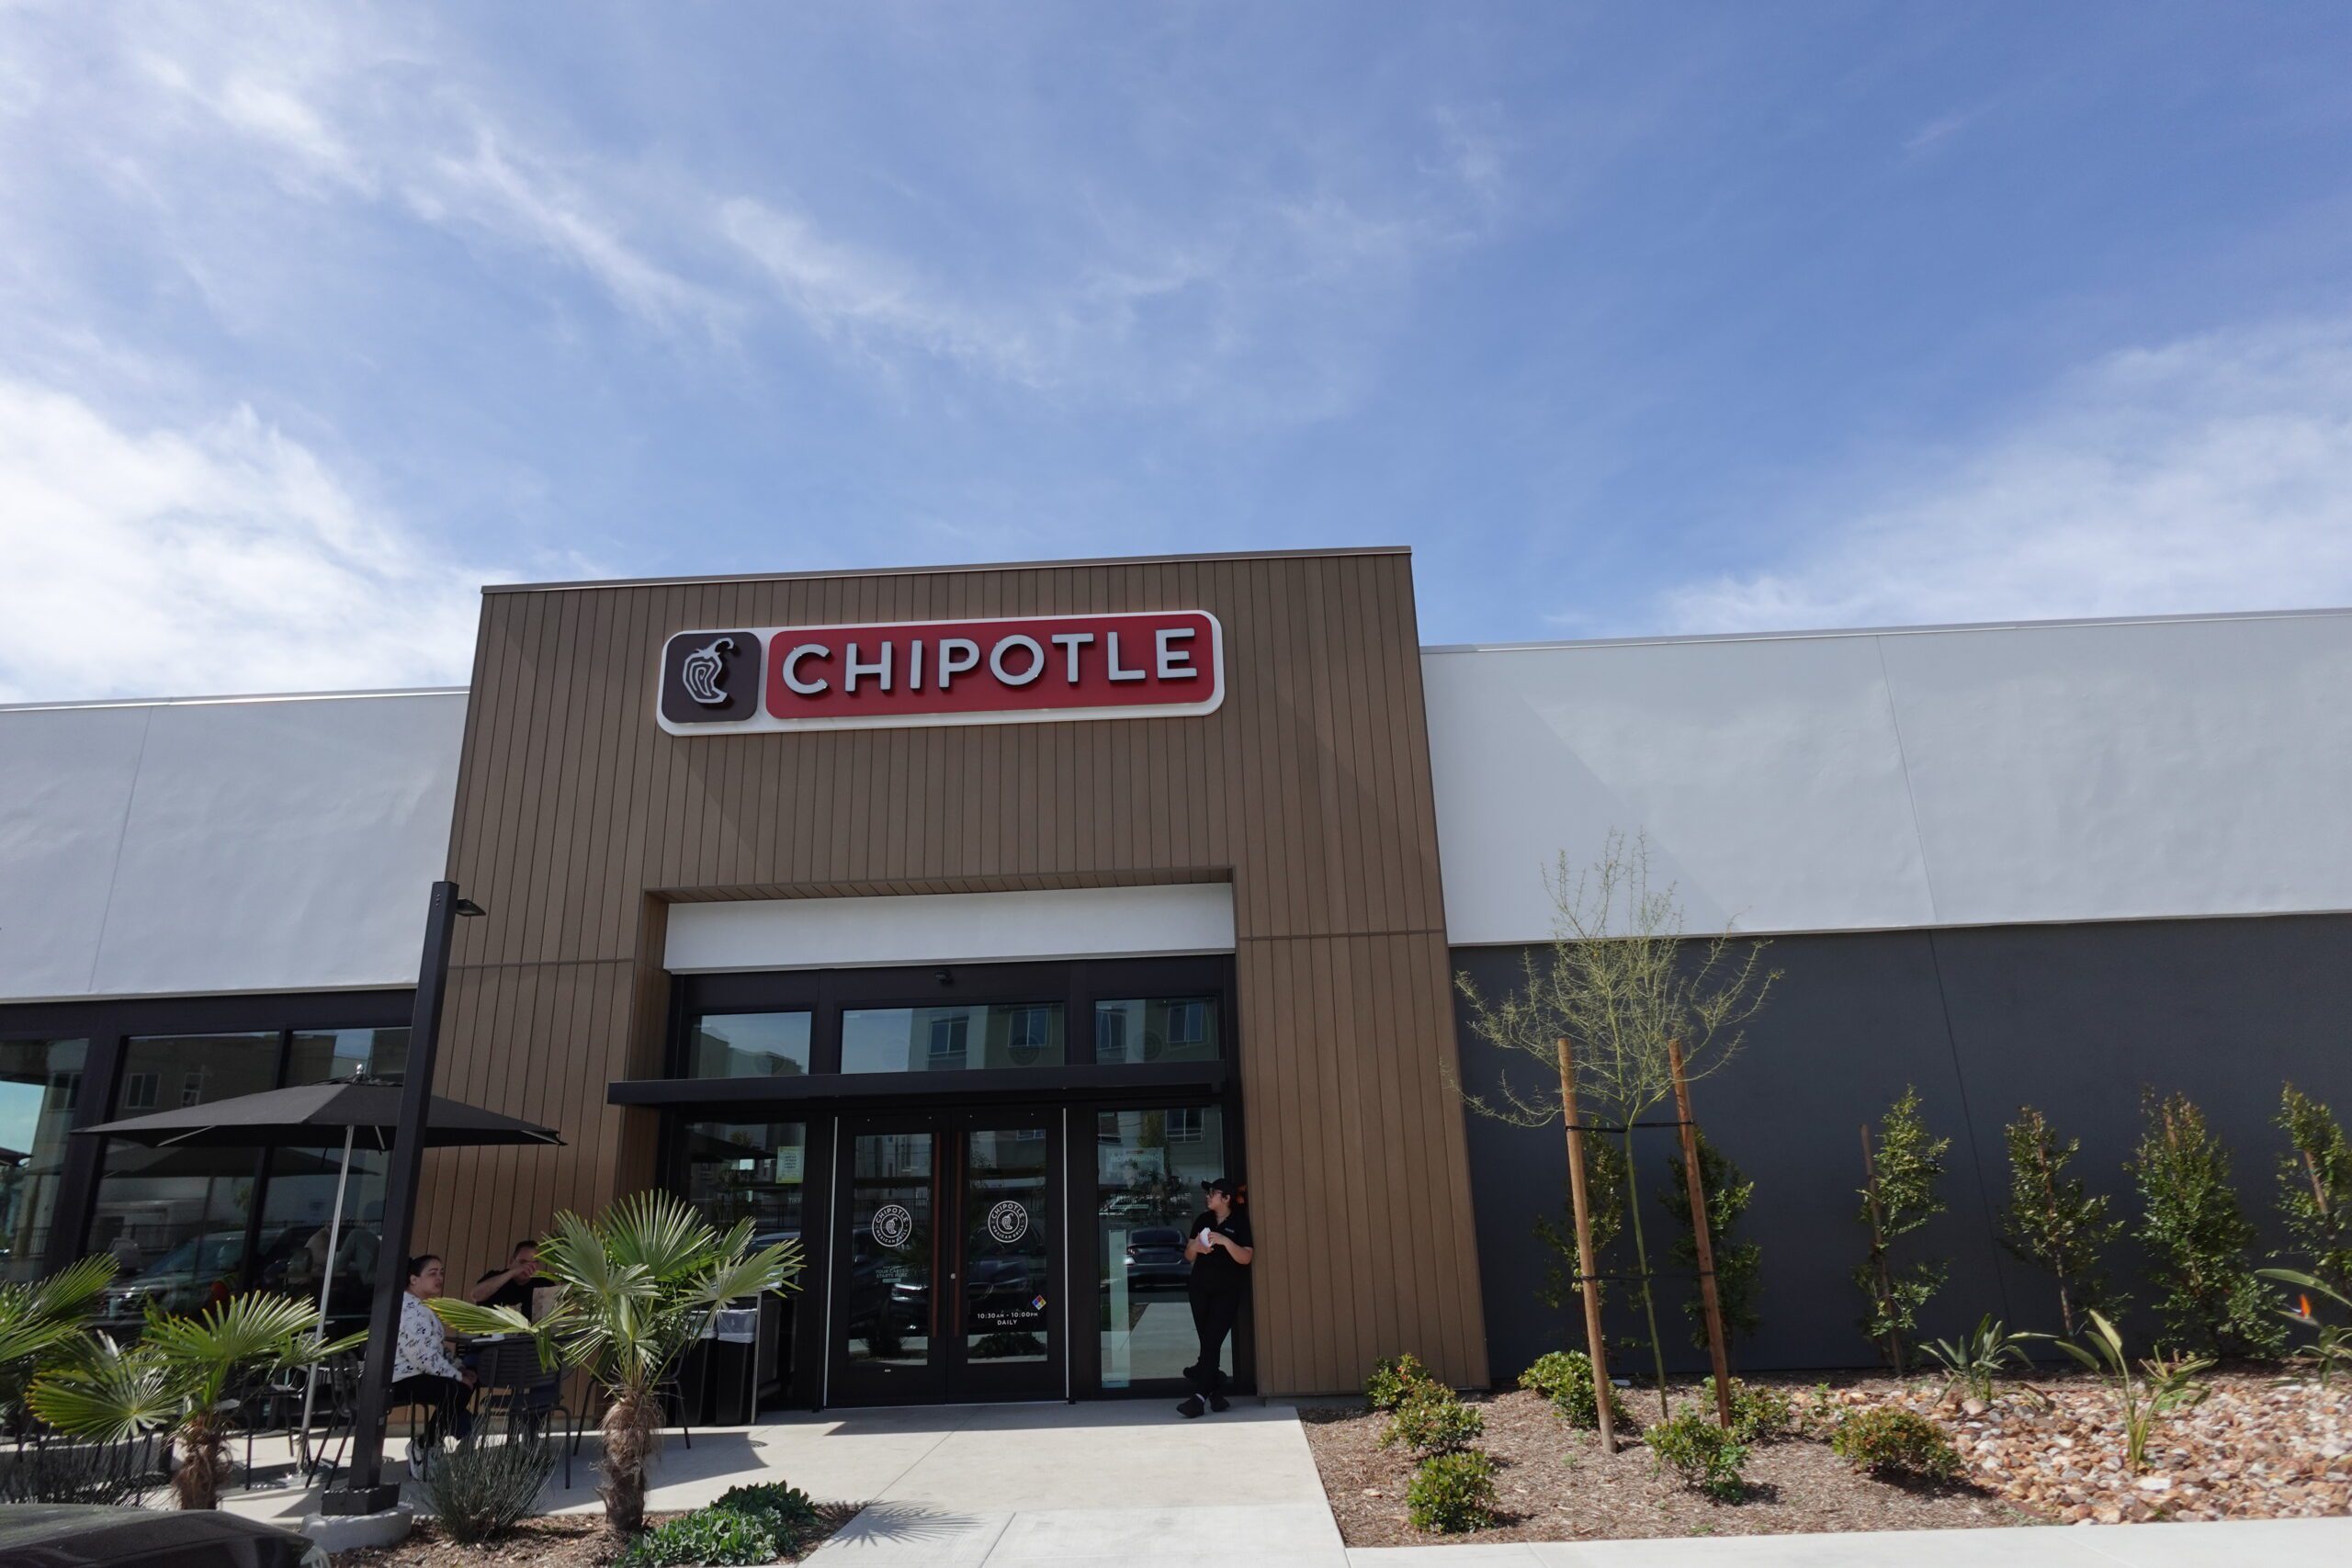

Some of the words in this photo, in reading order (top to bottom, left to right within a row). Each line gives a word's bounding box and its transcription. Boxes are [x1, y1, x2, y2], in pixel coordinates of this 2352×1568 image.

[782, 627, 1197, 694] CHIPOTLE
[876, 1207, 909, 1224] CHIPOTLE
[991, 1203, 1024, 1219] CHIPOTLE
[876, 1229, 896, 1244] MEXICAN
[992, 1225, 1012, 1239] MEXICAN
[1012, 1224, 1024, 1238] GRILL
